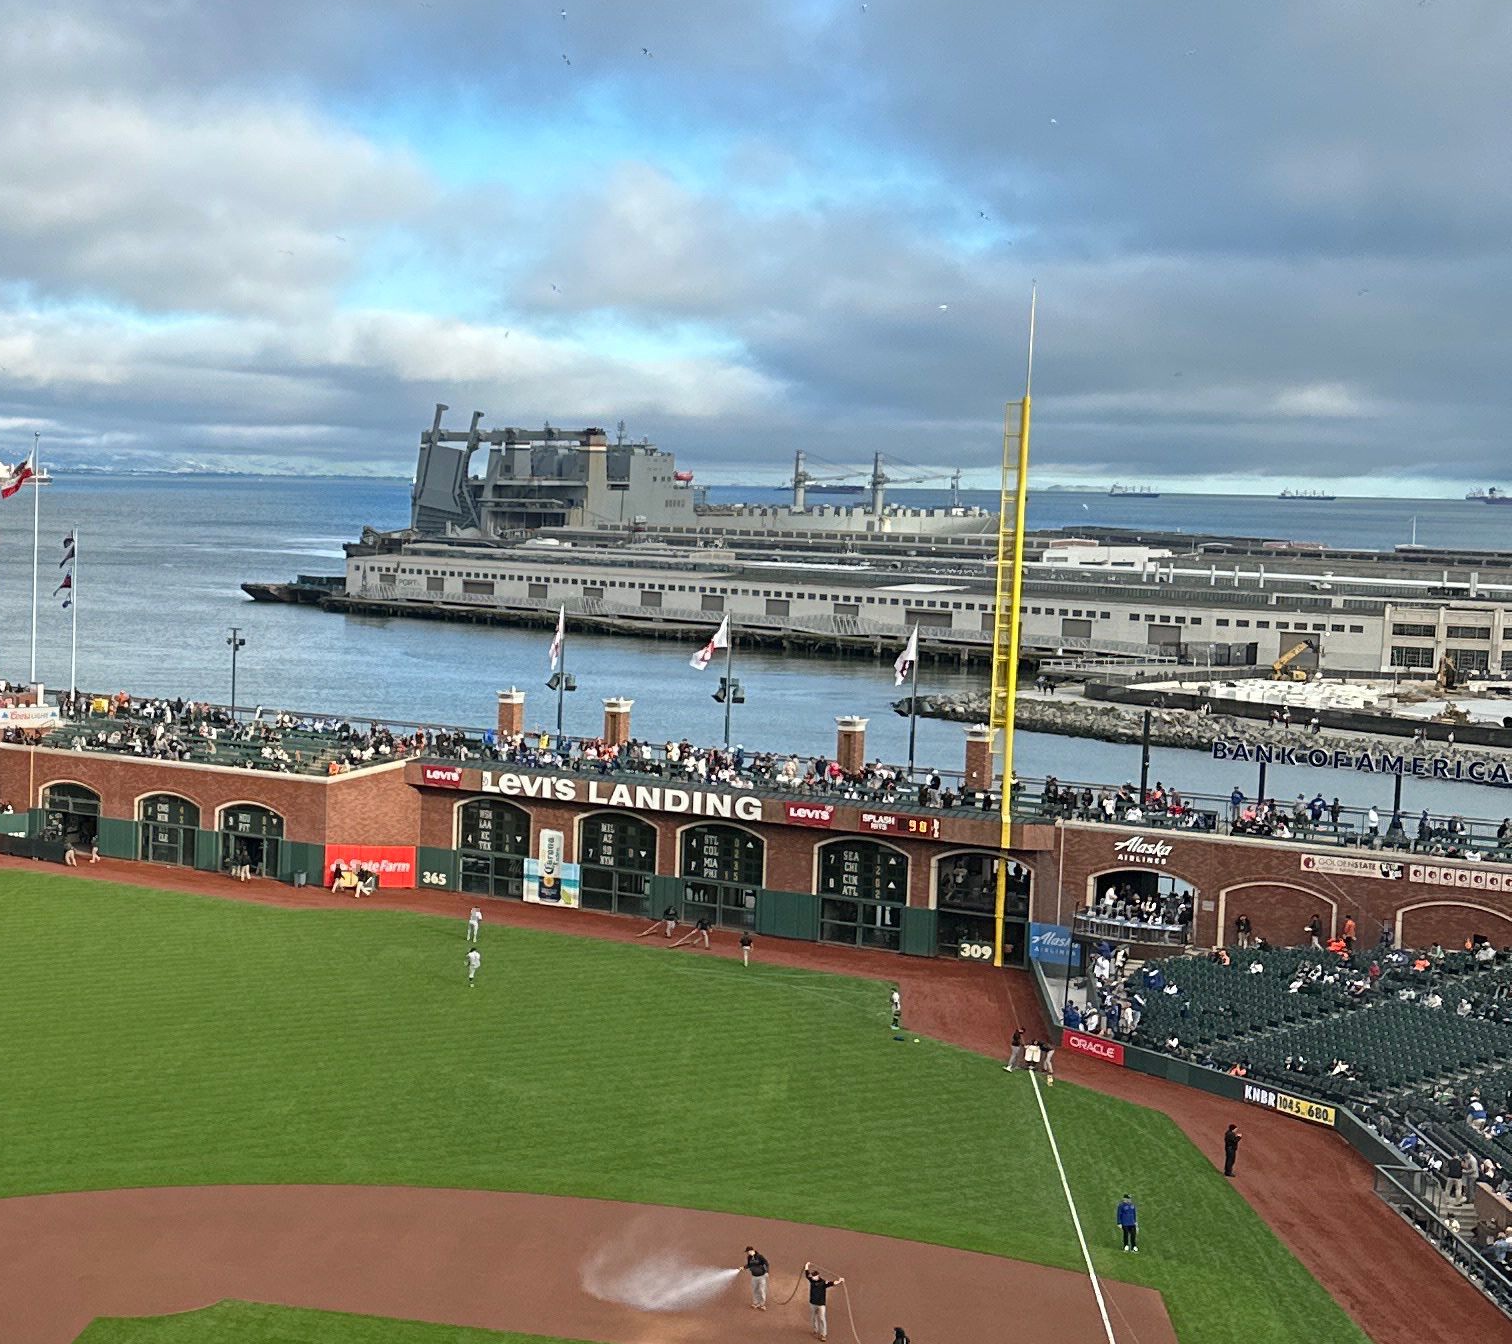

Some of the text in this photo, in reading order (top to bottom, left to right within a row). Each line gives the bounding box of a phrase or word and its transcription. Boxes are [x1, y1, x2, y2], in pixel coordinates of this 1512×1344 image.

[1212, 740, 1512, 783] BANK OF AMERICA
[588, 781, 763, 821] LANDING
[862, 813, 895, 825] SPLASH
[544, 837, 555, 874] Corona
[1114, 836, 1173, 857] Alaska
[843, 850, 859, 862] SEA
[1117, 853, 1167, 865] AIRLINES
[422, 871, 447, 885] 365
[842, 886, 859, 897] ATL
[960, 943, 992, 959] 309
[1069, 1036, 1115, 1059] ORACLE
[1245, 1085, 1276, 1107] KNBR
[1307, 1105, 1328, 1122] 680
